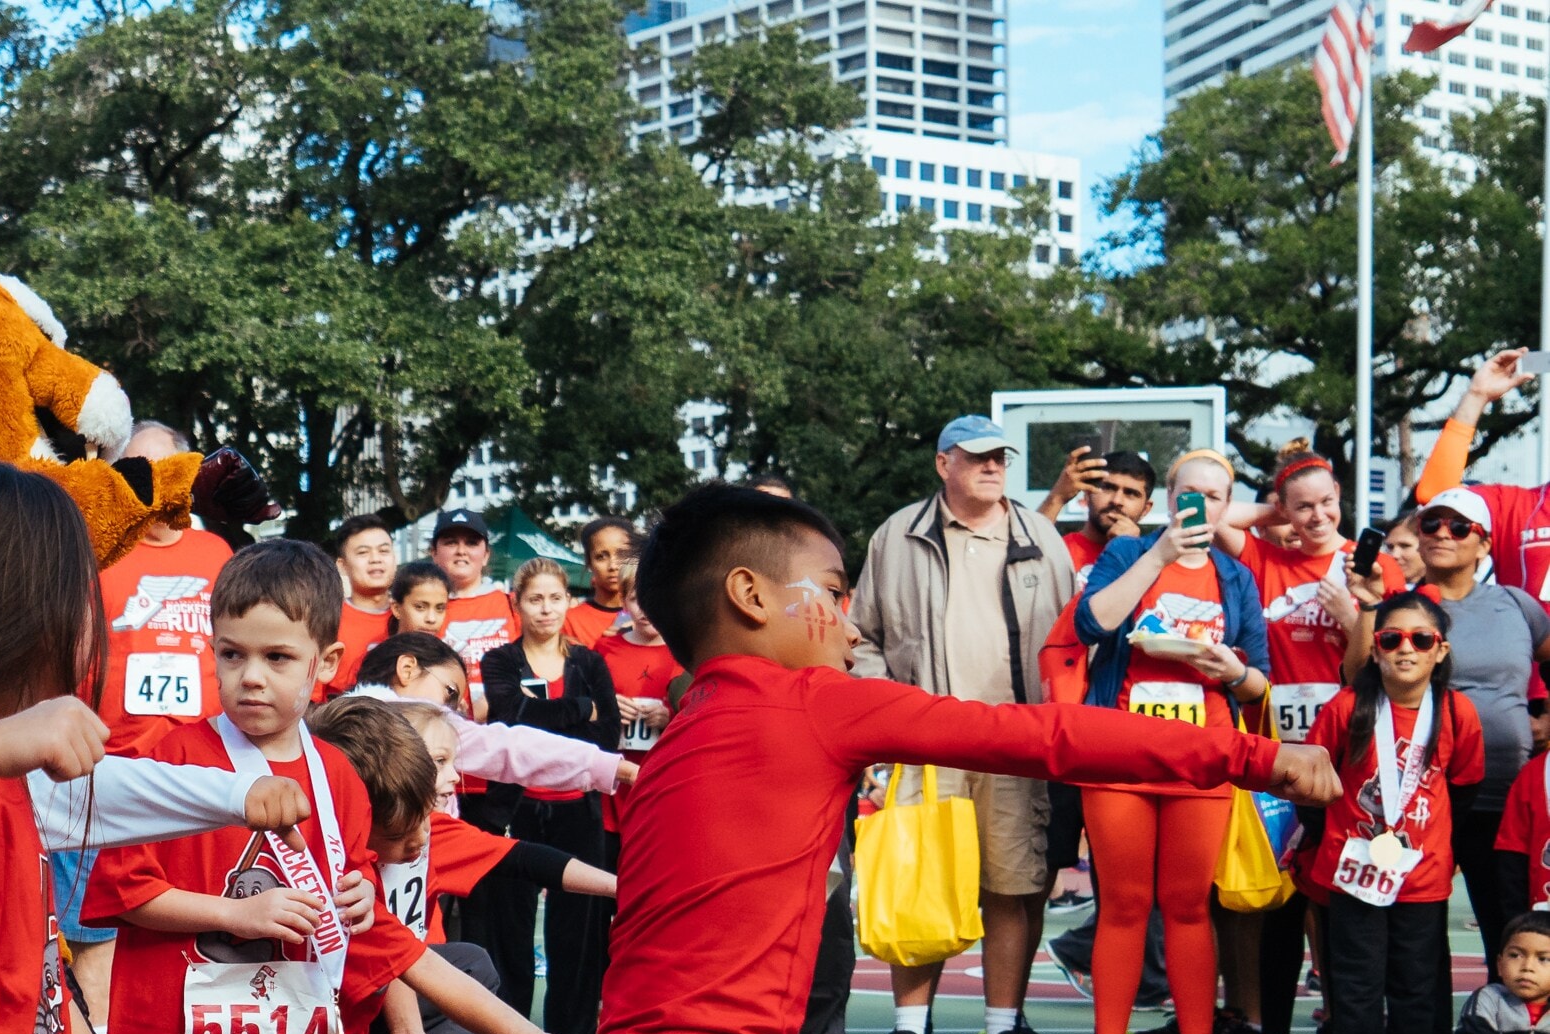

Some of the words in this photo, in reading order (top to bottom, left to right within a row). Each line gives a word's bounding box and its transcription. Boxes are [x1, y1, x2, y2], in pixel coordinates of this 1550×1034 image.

[167, 612, 213, 637] RUN
[138, 675, 189, 703] 475
[1339, 857, 1407, 895] 566
